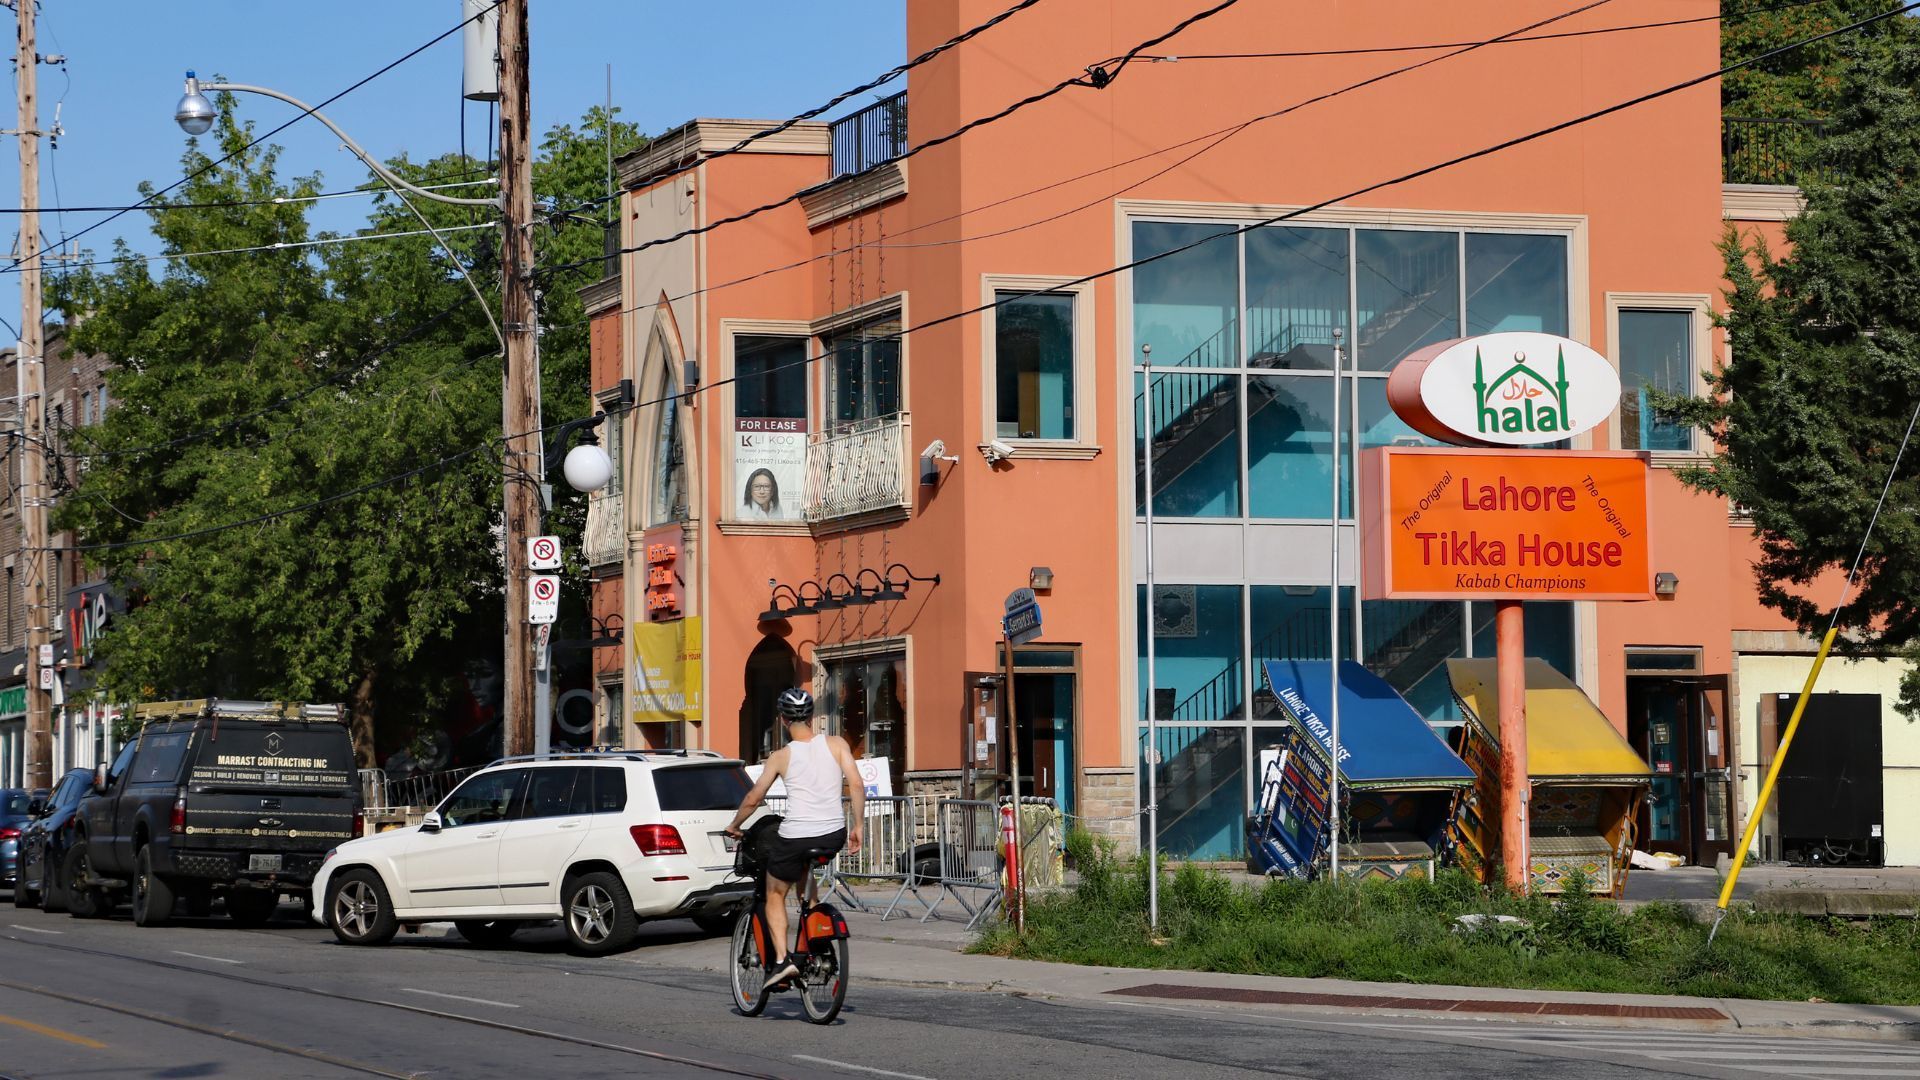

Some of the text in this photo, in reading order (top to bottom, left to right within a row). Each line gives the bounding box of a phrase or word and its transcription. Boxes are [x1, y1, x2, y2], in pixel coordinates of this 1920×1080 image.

[1502, 377, 1544, 401] حلال
[740, 420, 796, 430] FOR LEASE
[1474, 396, 1571, 433] halal
[769, 436, 794, 445] KOO
[1401, 470, 1453, 532] The Original
[1462, 476, 1576, 512] Lahore
[1582, 474, 1632, 539] The Original
[1415, 531, 1622, 567] Tikka House
[1456, 573, 1586, 592] Kabab Champions
[1280, 688, 1310, 716] LAHORE
[1302, 710, 1330, 738] TIKKA
[218, 755, 327, 768] MARRAST CONTRACTING INC
[1297, 745, 1324, 776] LAHORE
